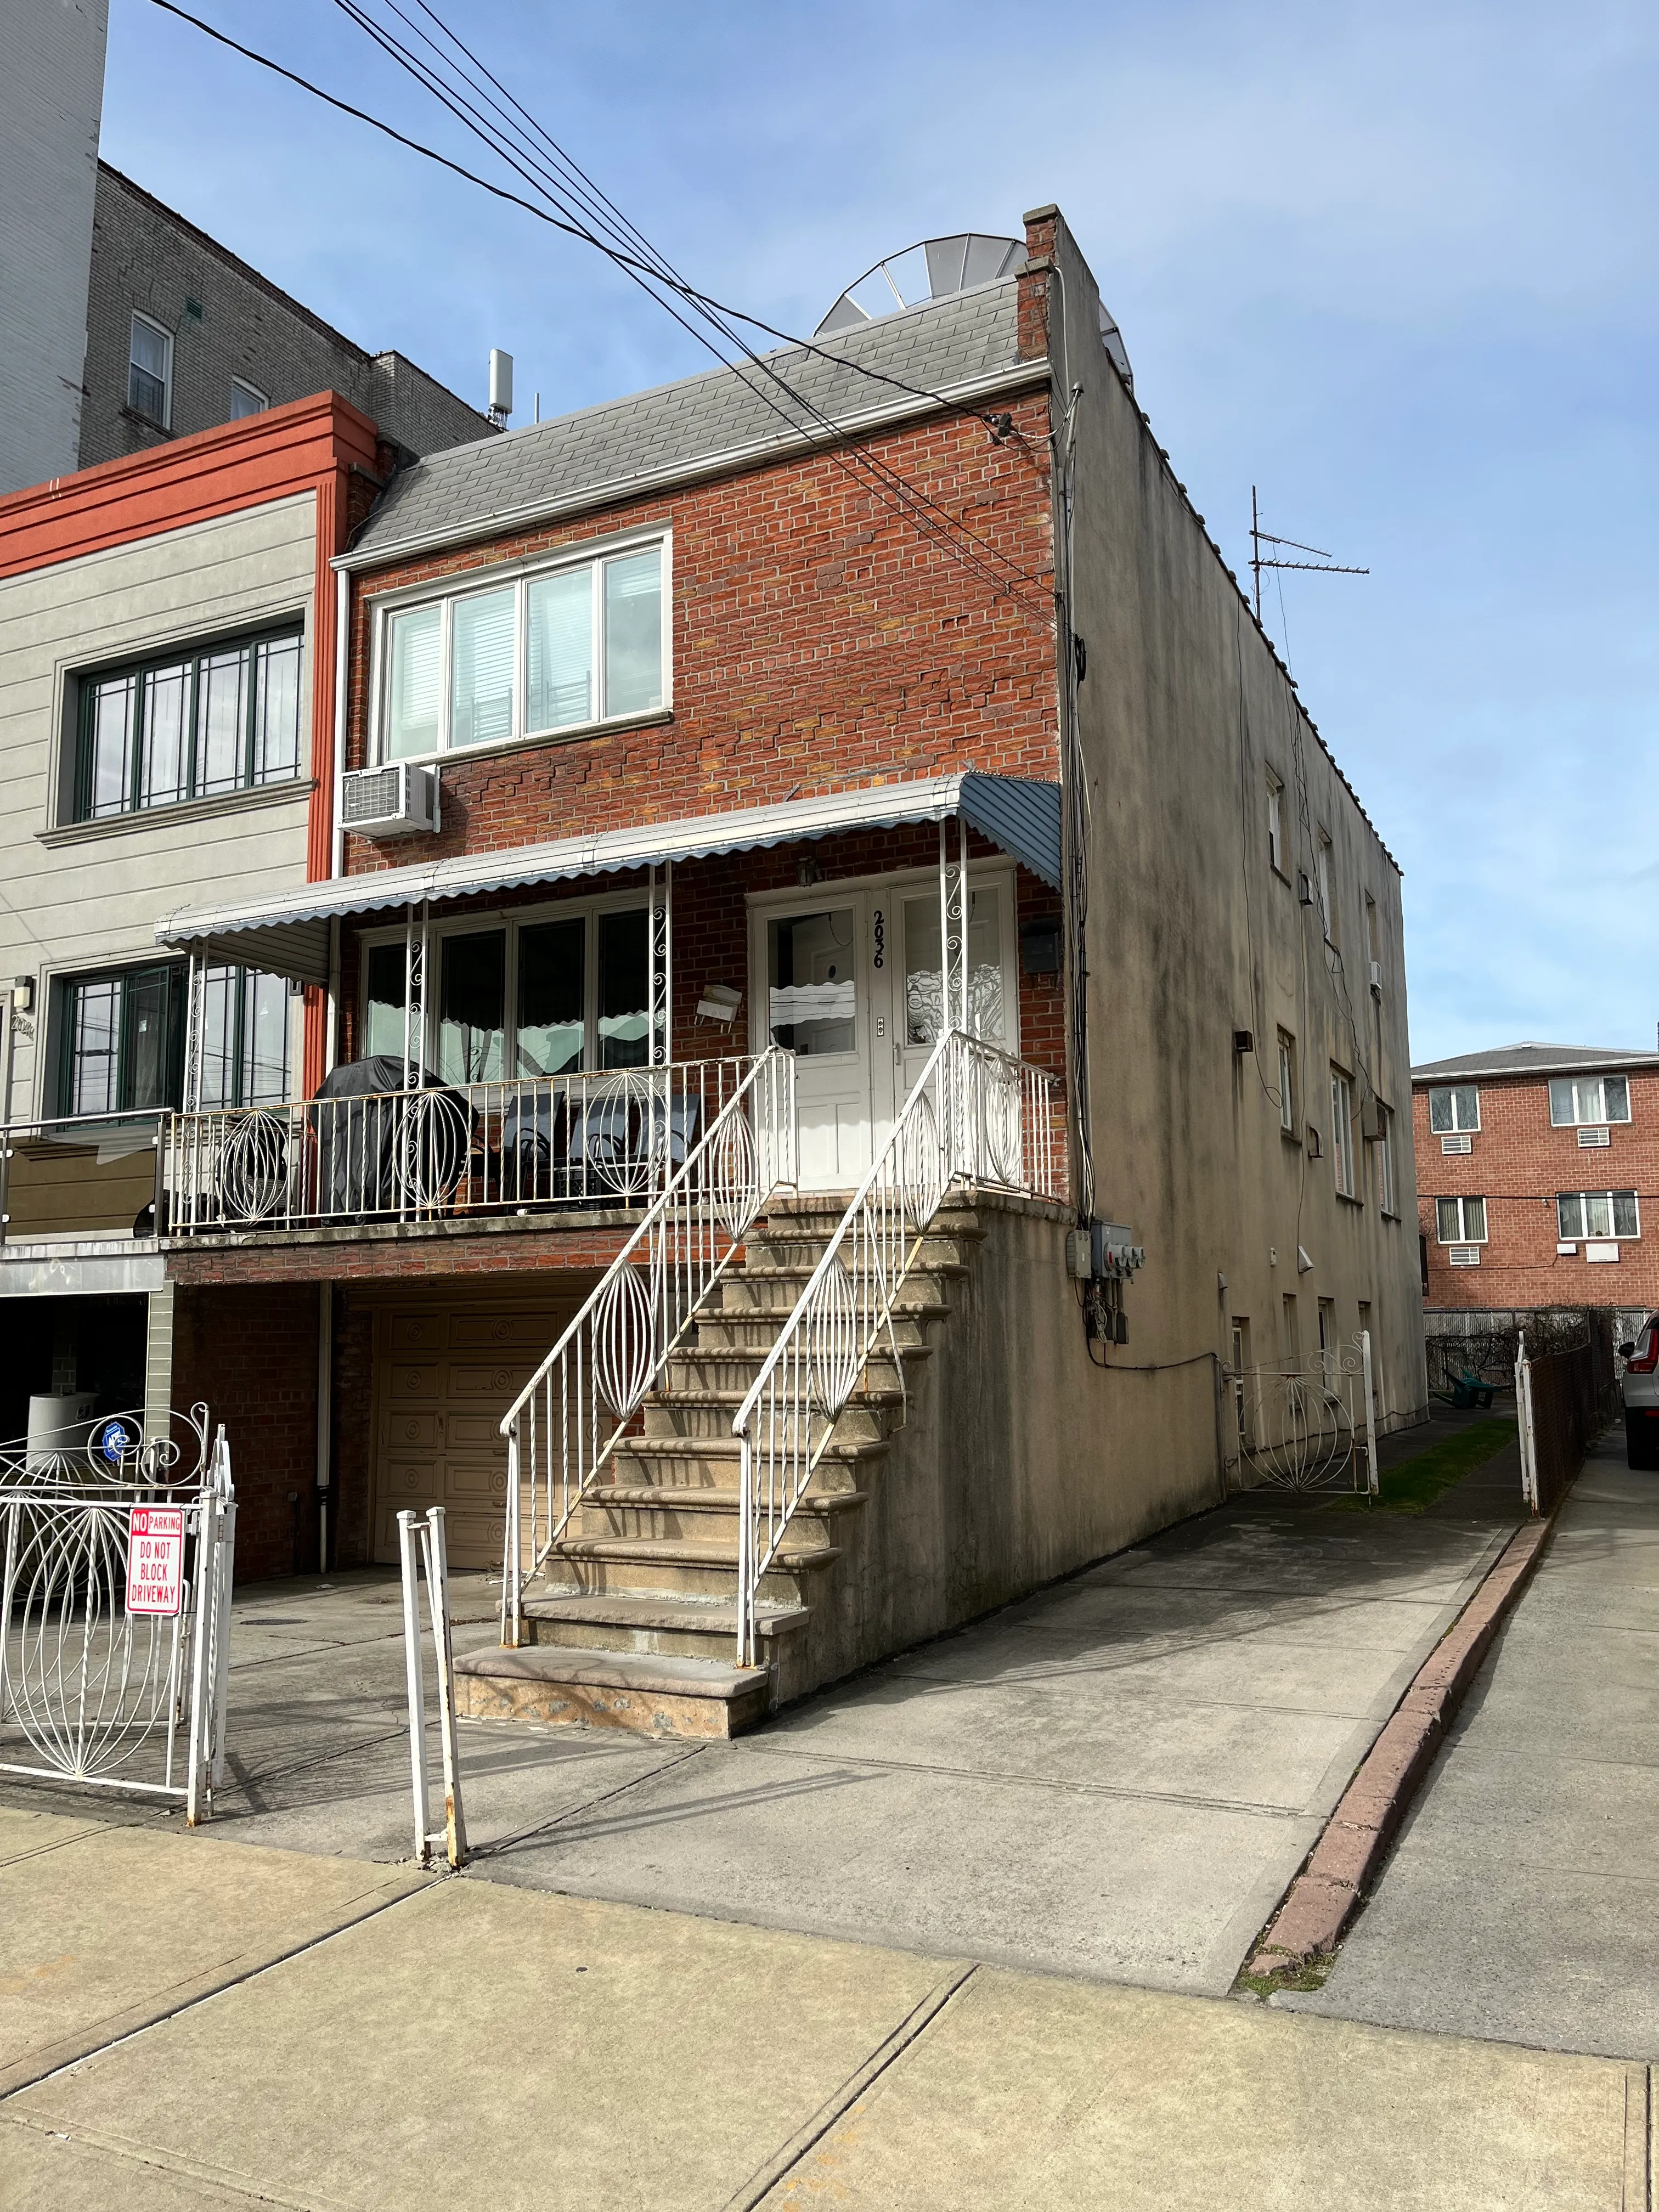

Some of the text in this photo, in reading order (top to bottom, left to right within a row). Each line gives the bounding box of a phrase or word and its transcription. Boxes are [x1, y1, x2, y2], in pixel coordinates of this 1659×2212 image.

[874, 910, 884, 968] 2036
[133, 1513, 180, 1532] NO PARKING
[140, 1541, 171, 1559] DO NOT
[140, 1562, 167, 1581] BLOCK
[132, 1584, 175, 1603] DRIVEWAY
